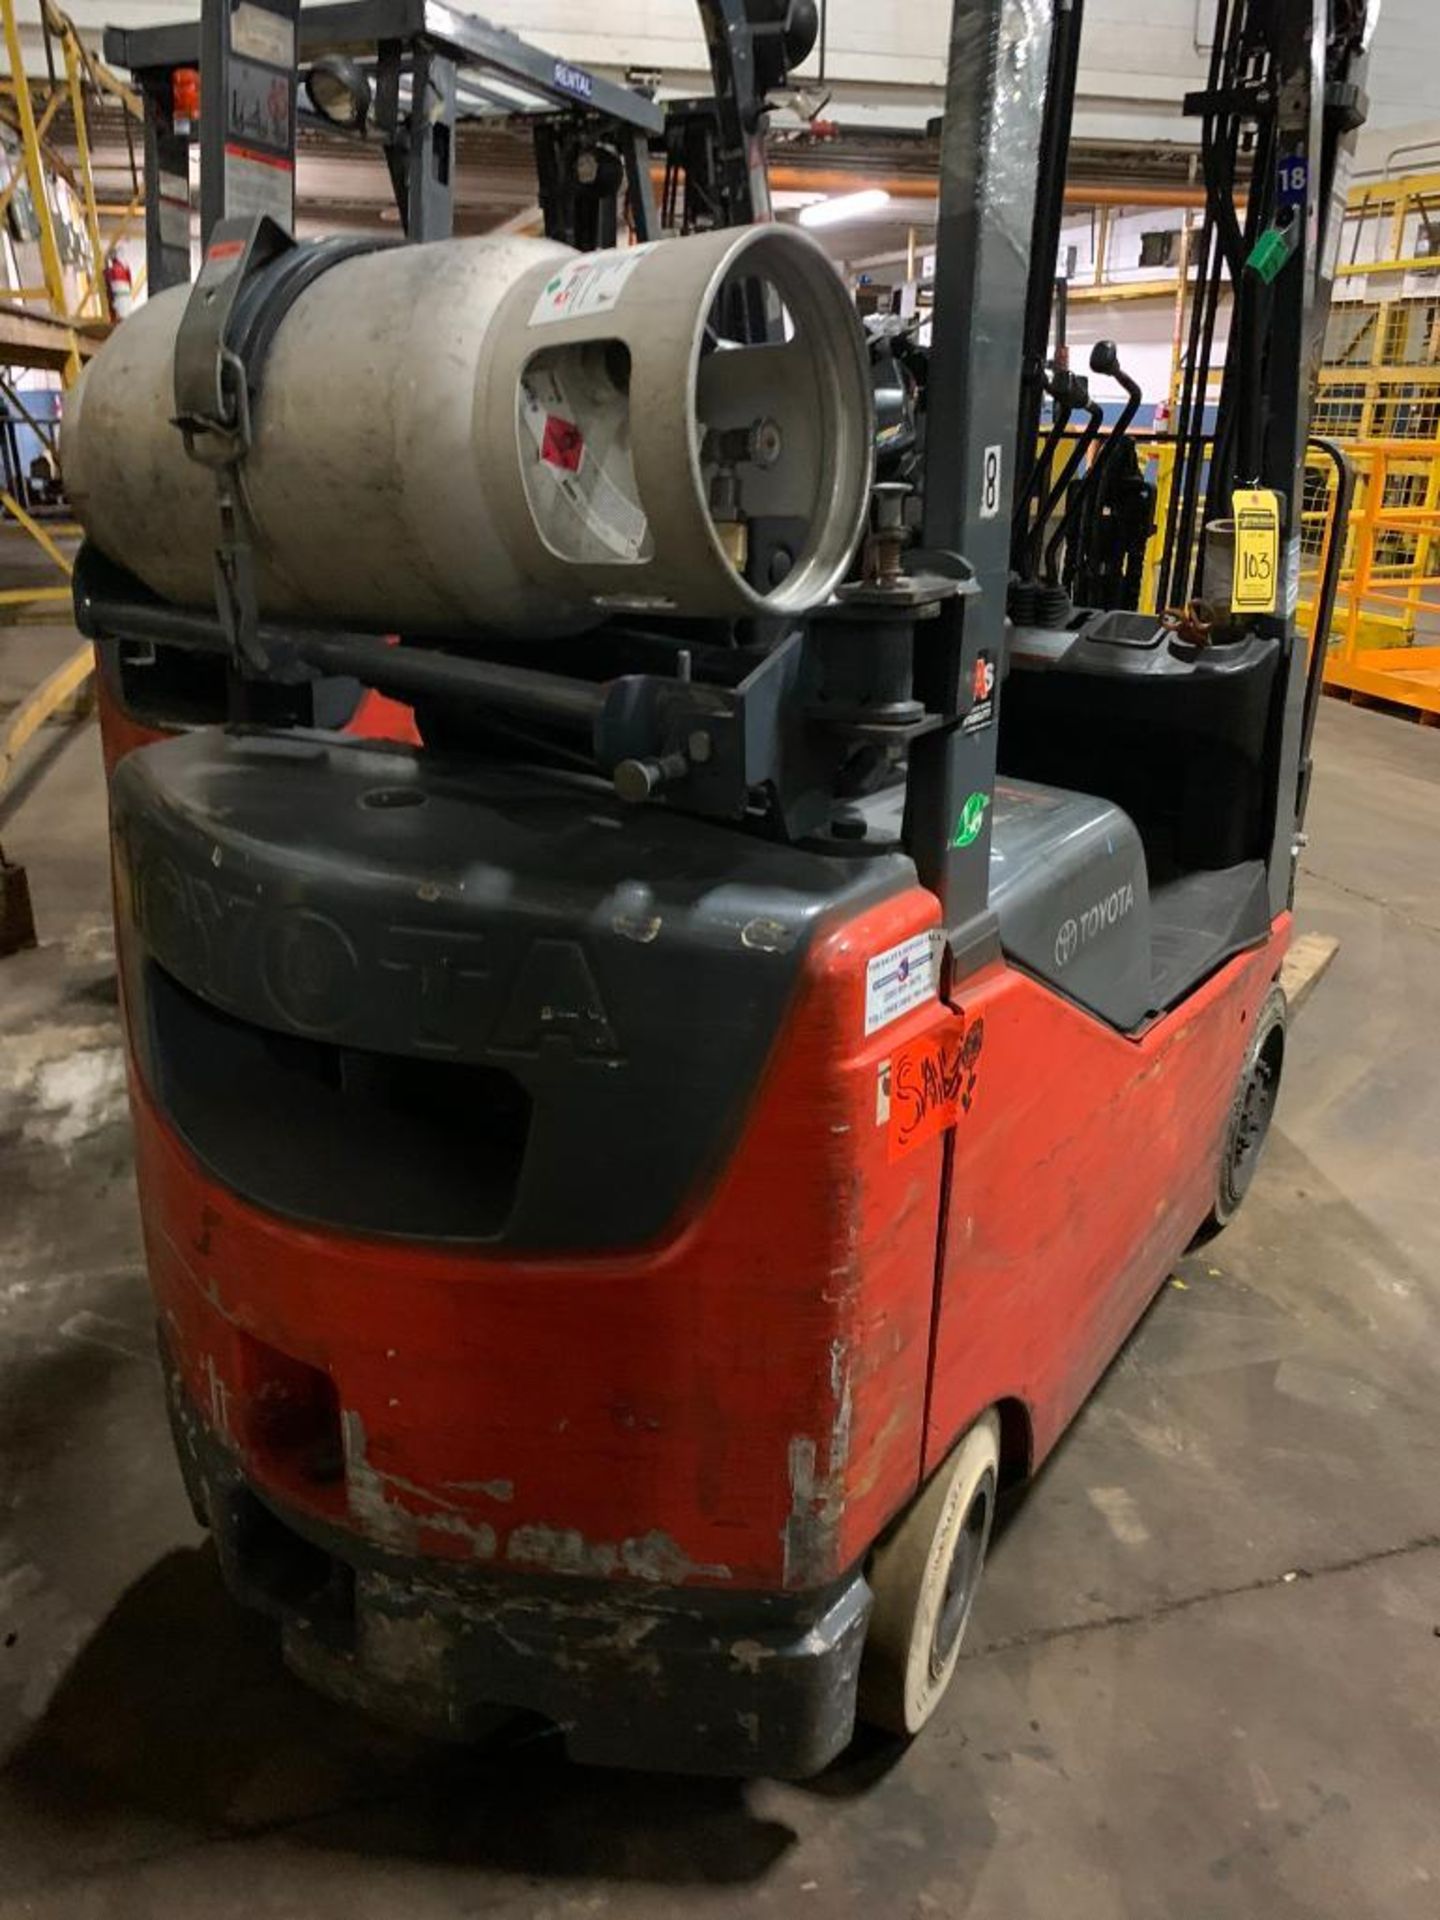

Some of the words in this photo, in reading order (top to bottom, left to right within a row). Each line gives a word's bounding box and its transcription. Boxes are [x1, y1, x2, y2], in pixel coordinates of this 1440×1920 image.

[555, 64, 592, 96] RENTAL
[1278, 167, 1306, 192] 18
[1244, 552, 1271, 580] 103
[1080, 883, 1134, 944] TOYOTA
